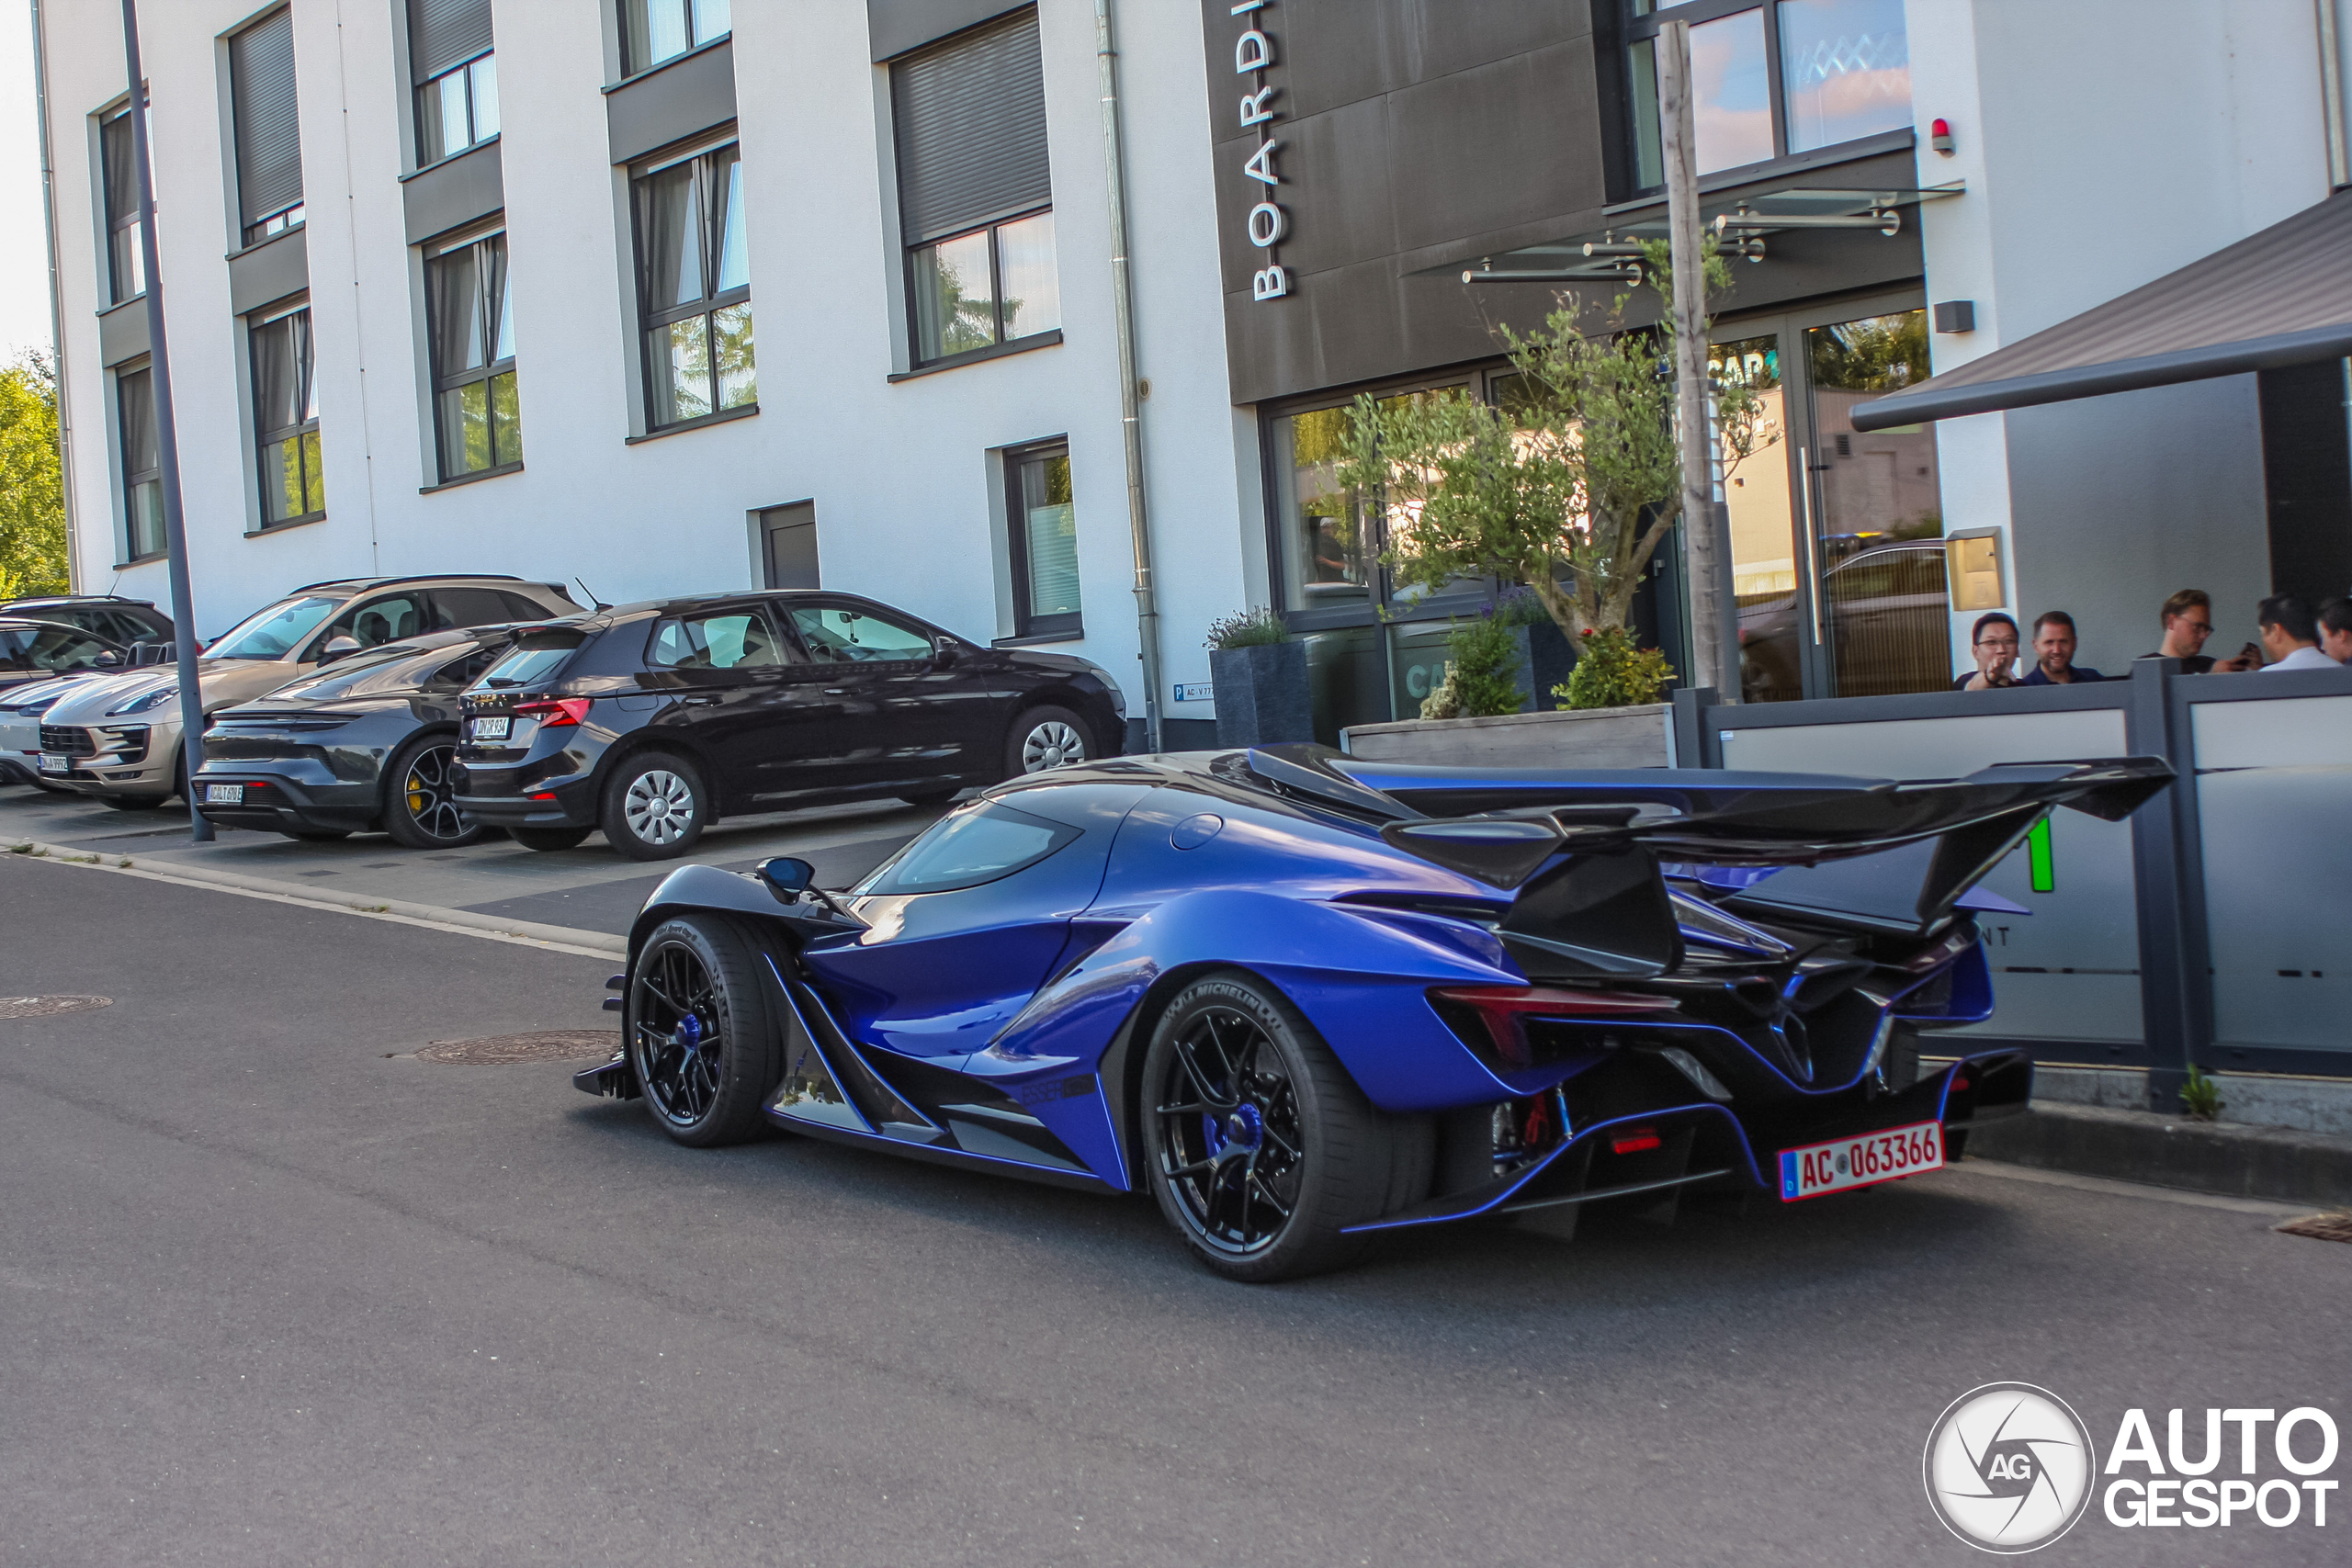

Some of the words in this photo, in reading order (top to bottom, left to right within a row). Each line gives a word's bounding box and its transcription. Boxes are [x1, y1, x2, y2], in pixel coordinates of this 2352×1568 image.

[1196, 983, 1261, 1011] MICHELIN
[1803, 1149, 1834, 1190] AC
[1850, 1128, 1937, 1179] 063366
